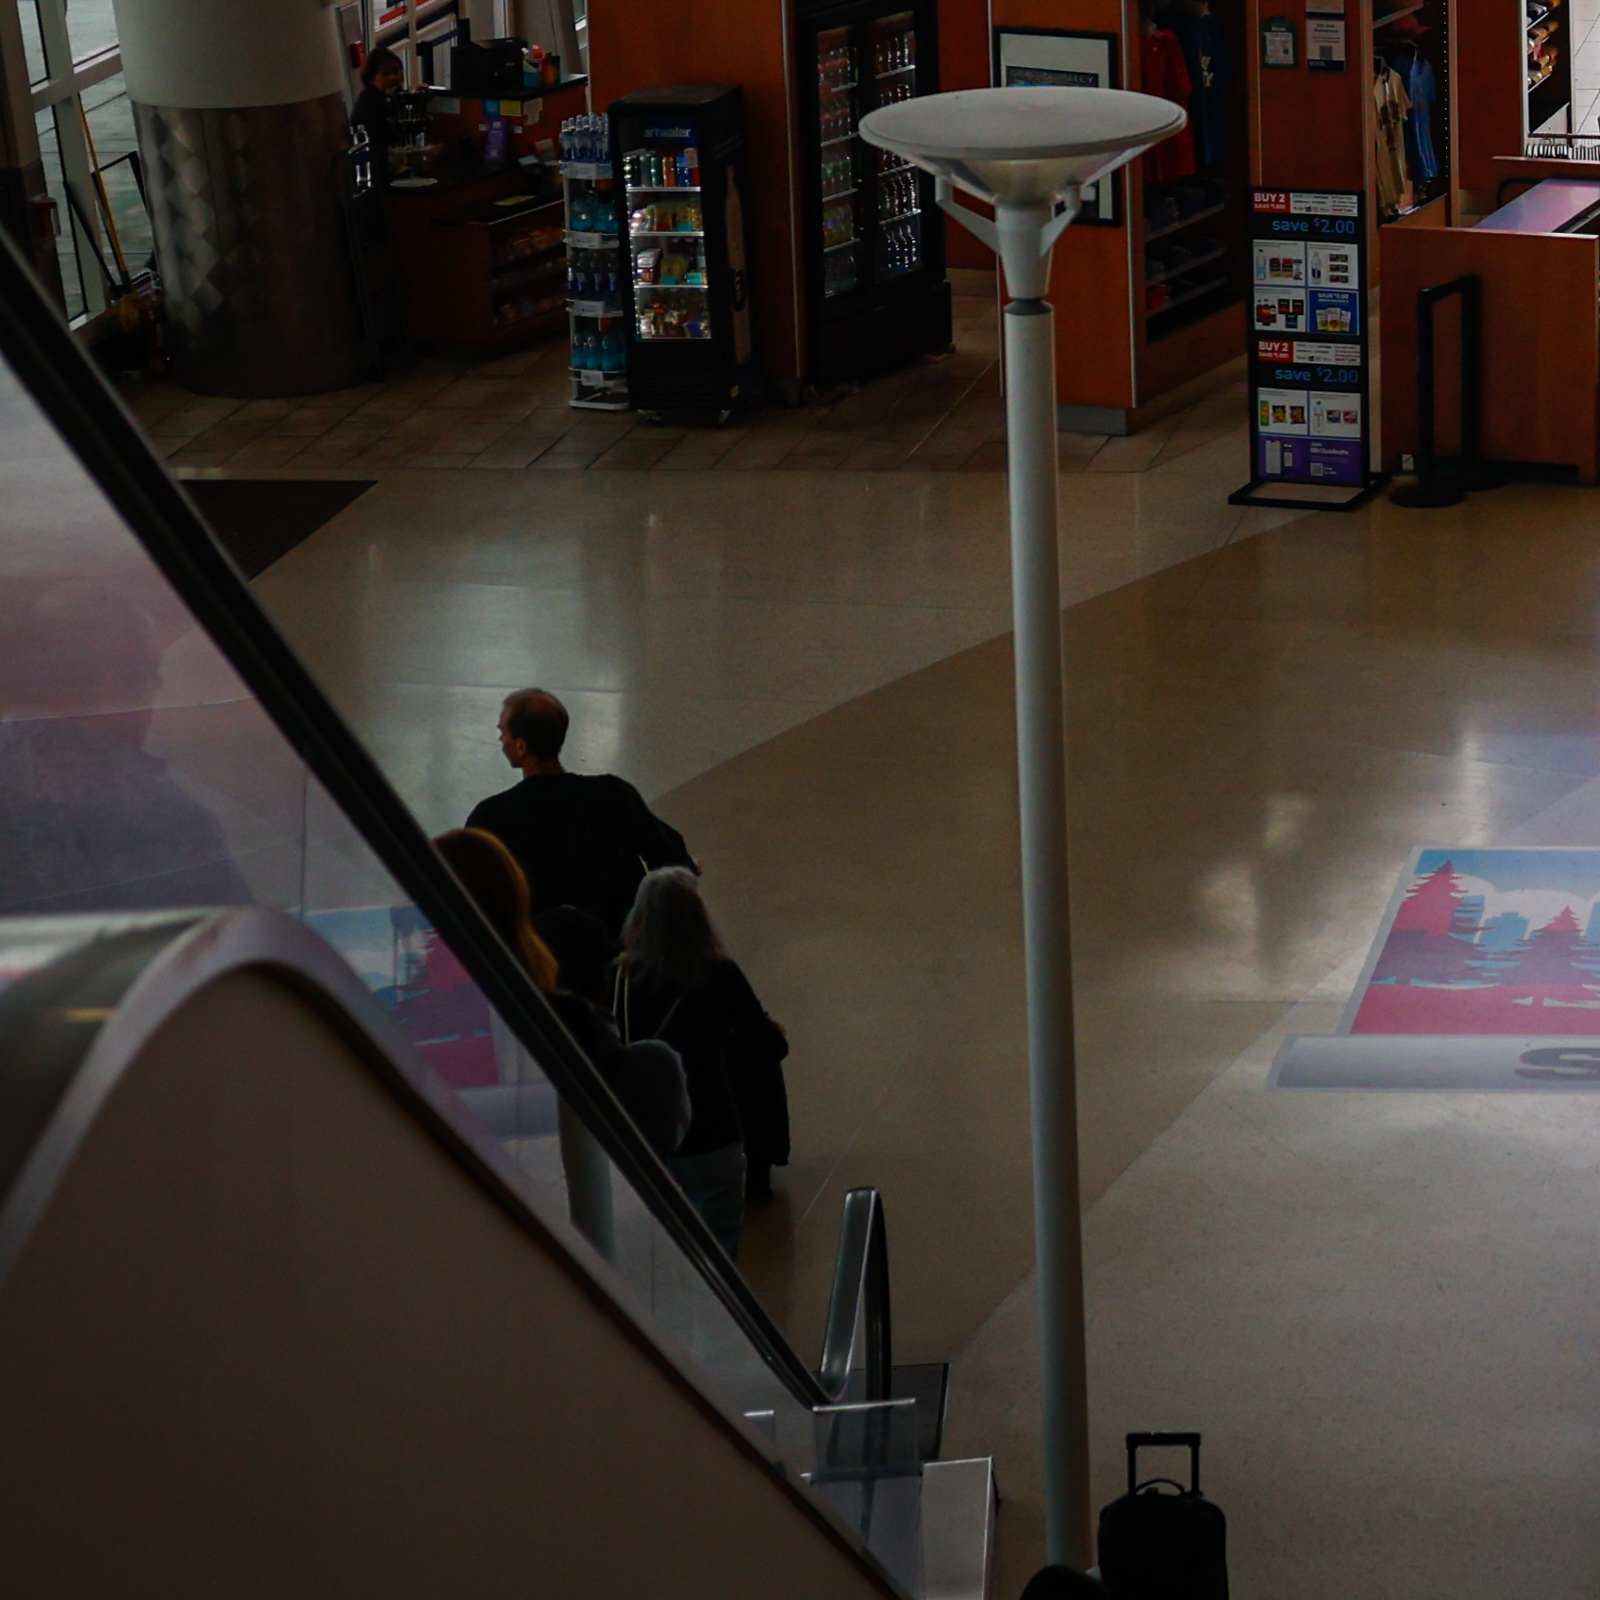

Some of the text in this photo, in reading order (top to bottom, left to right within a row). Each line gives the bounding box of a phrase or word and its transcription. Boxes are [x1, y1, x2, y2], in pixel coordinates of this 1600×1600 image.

[643, 127, 691, 138] artwater
[1254, 192, 1276, 203] BUY
[1279, 193, 1286, 203] 2
[1272, 217, 1356, 234] save $2.00
[1258, 341, 1280, 351] BUY
[1282, 342, 1289, 352] 2
[1275, 366, 1359, 383] save $2.00
